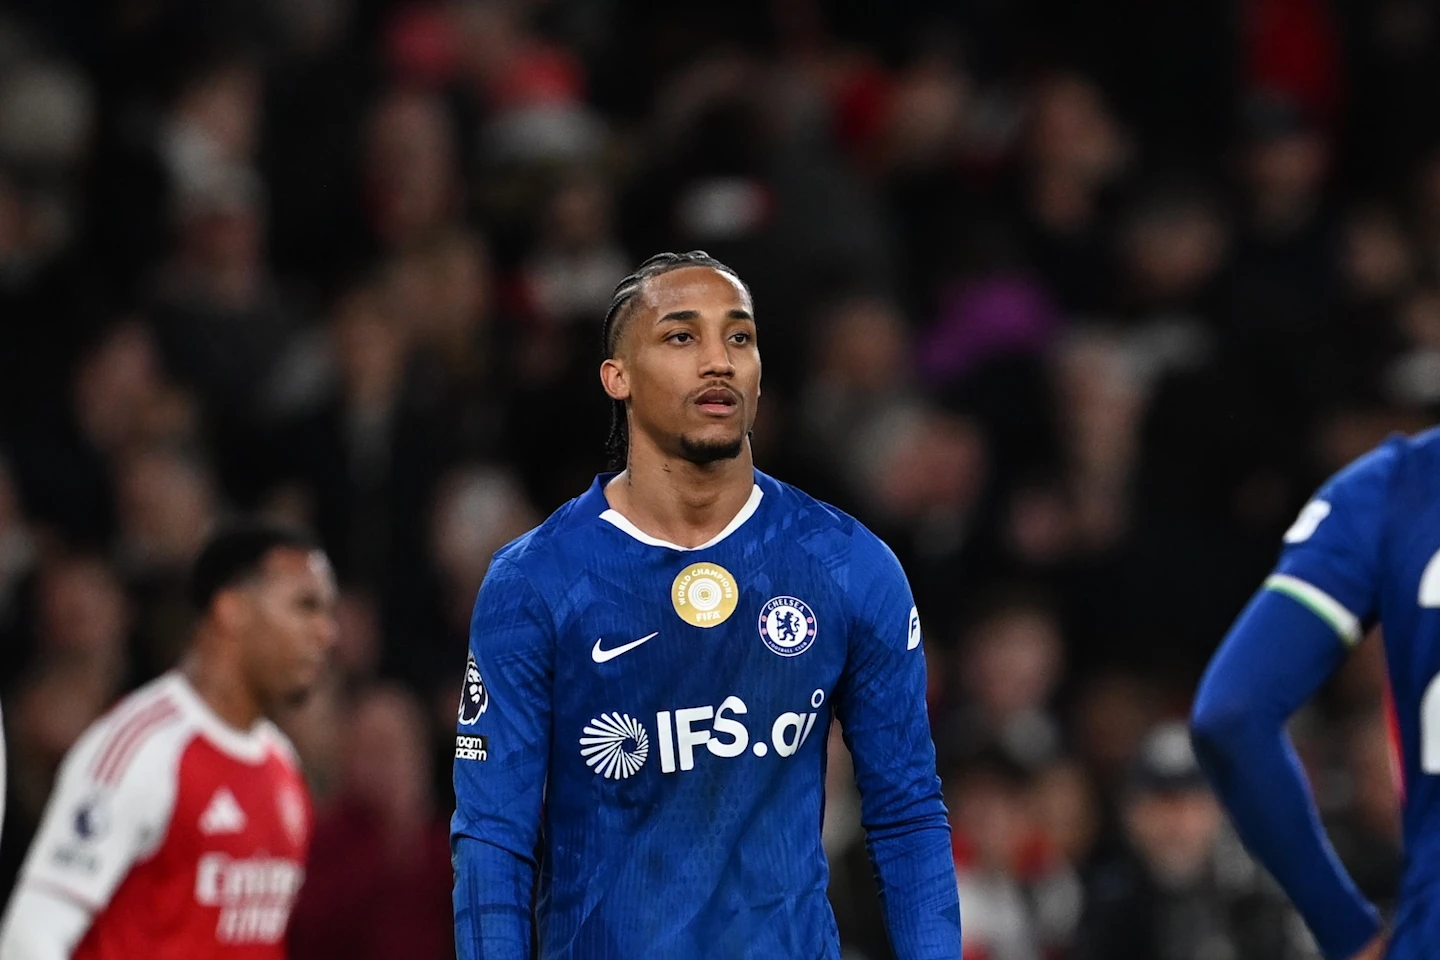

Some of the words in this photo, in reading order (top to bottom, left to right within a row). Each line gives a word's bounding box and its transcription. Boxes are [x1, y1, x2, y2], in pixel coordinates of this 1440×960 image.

[677, 574, 692, 606] WORLD
[691, 568, 733, 599] CHAMPIONS
[695, 610, 721, 623] FIFA
[767, 598, 805, 612] CHELSEA
[656, 688, 825, 774] IFS.ai
